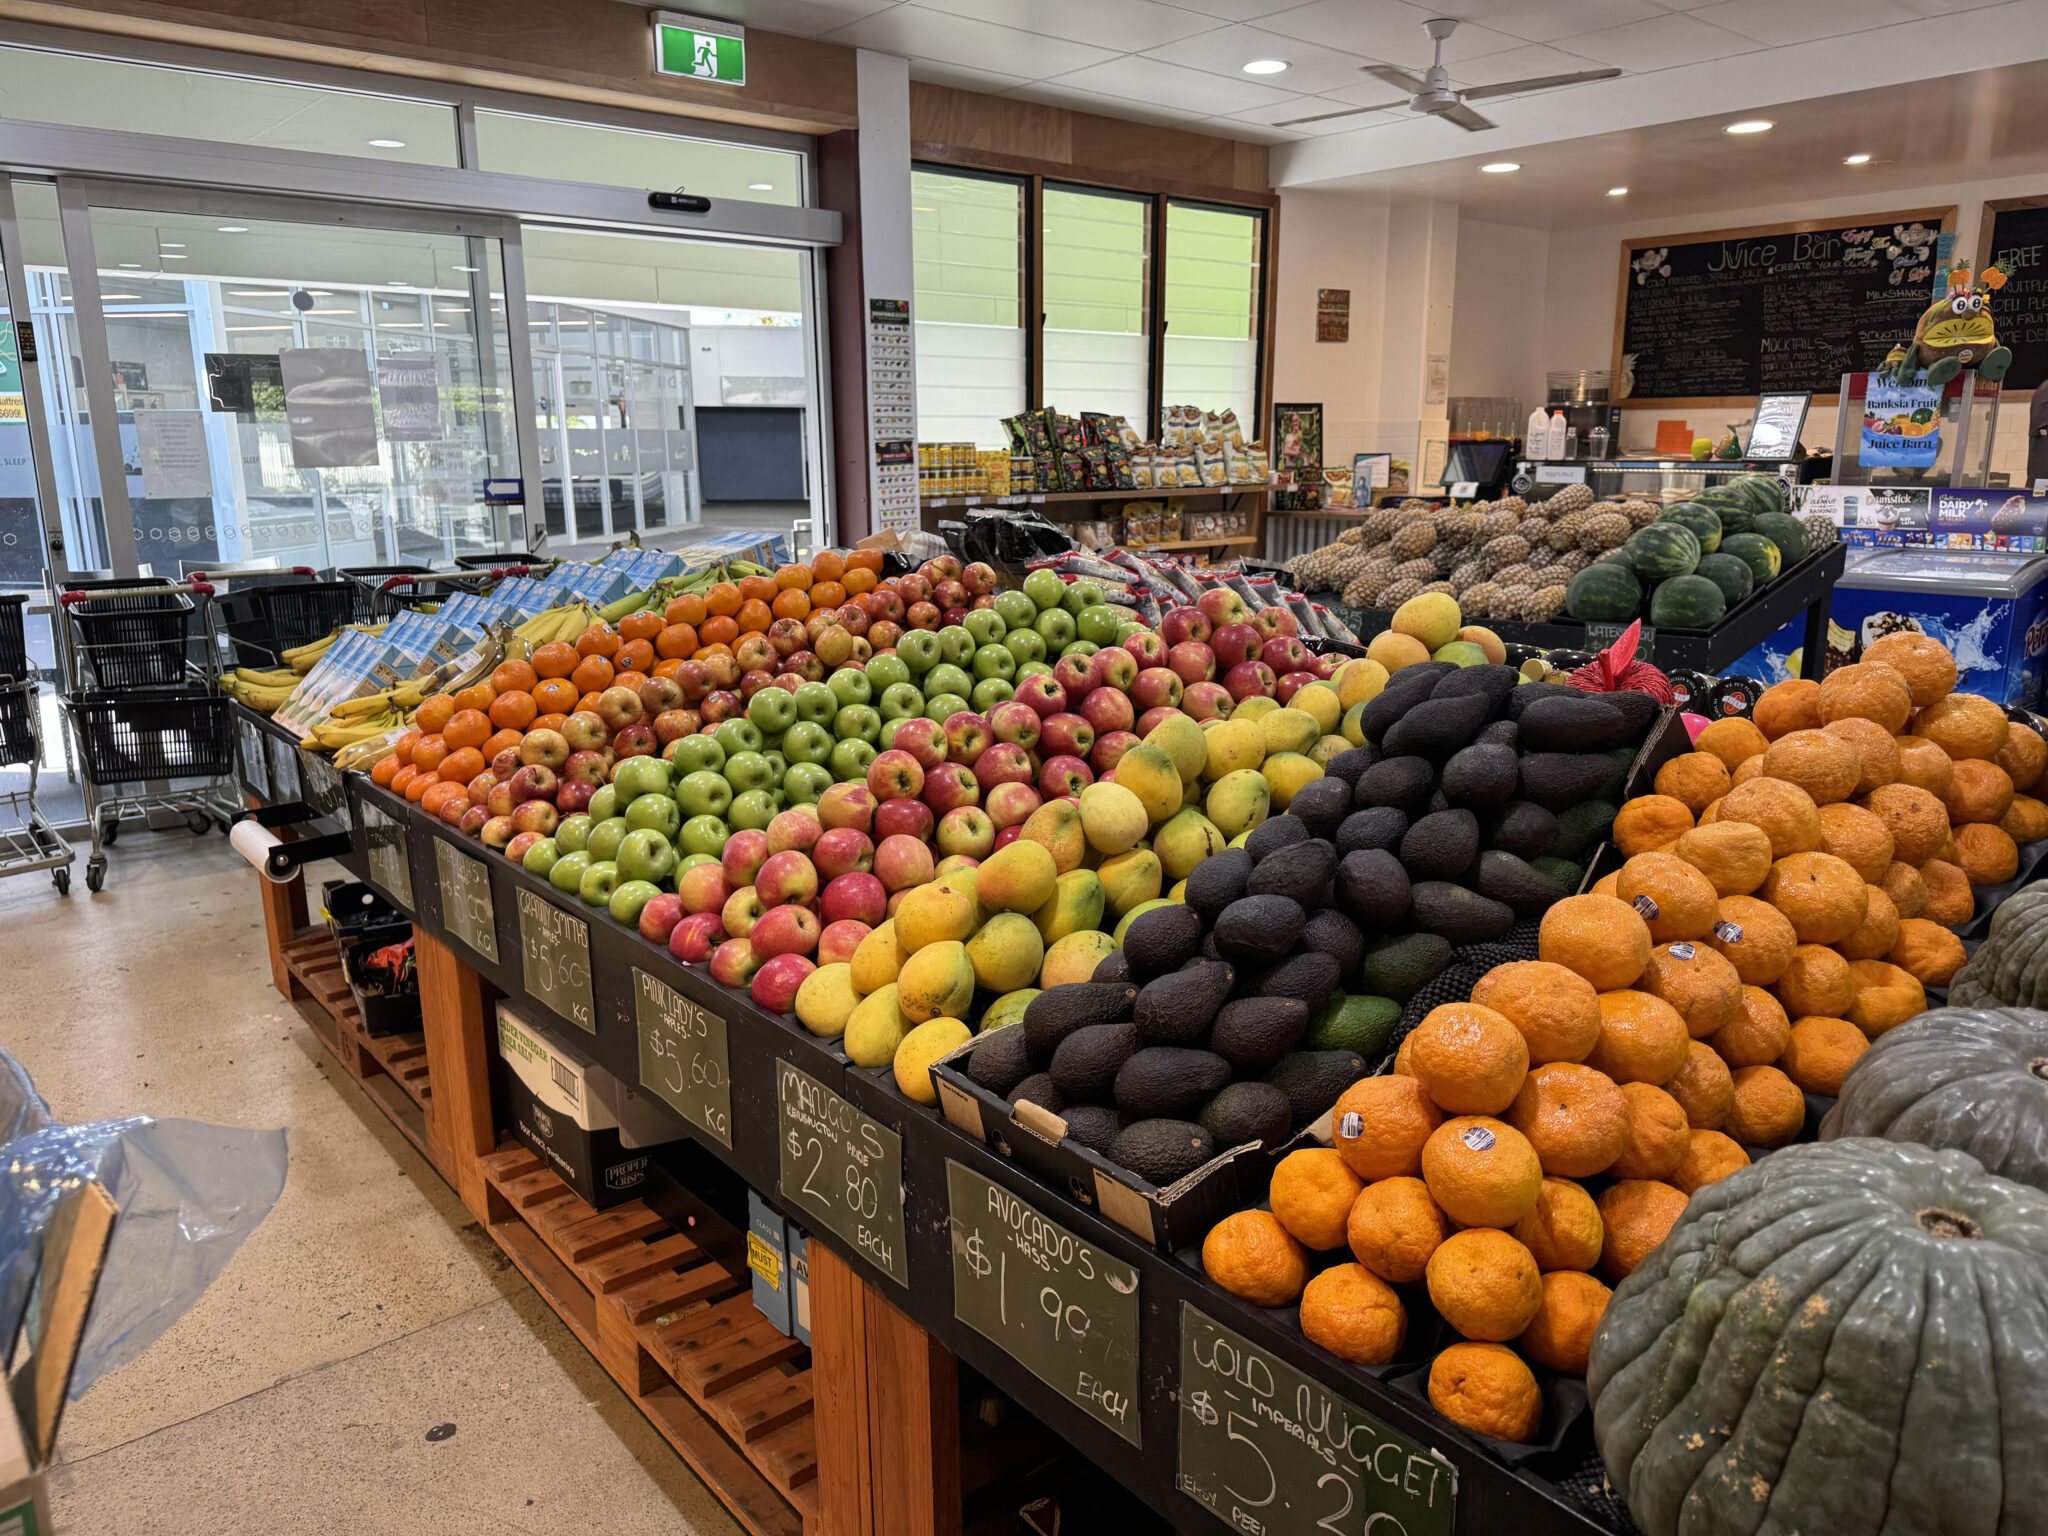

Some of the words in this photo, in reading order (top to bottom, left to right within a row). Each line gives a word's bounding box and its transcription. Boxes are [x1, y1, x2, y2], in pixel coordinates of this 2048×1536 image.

[1708, 241, 1777, 272] Juice
[1793, 233, 1840, 262] Bar
[1998, 245, 2044, 267] FREE
[1739, 269, 1763, 279] JUICE
[1775, 261, 1812, 273] CREATE
[1816, 260, 1842, 269] YOUR
[1866, 289, 1931, 300] MILKSHAKES
[1994, 315, 2014, 326] MIX
[1761, 337, 1828, 353] MOCKTAILS
[1858, 328, 1916, 340] SMOOTHIE
[1820, 342, 1854, 362] COMING
[1821, 356, 1851, 370] SOON
[1877, 378, 1932, 389] Weom
[1868, 399, 1909, 409] Banksia
[1911, 399, 1938, 409] Fruit
[1868, 439, 1899, 449] Juice
[1902, 439, 1932, 449] Barn
[1939, 501, 1974, 510] DAIRY
[1939, 509, 1968, 518] MILK
[519, 891, 551, 928] GRANNY
[553, 911, 588, 949] SMITHS
[476, 929, 492, 953] KG
[572, 1002, 589, 1026] KG
[641, 974, 667, 1011] PINK
[667, 989, 707, 1038] LADY'S
[505, 1034, 517, 1051] SEA
[517, 1043, 533, 1065] SALT
[518, 1031, 549, 1065] VINEGAR
[649, 1028, 721, 1094] $5.60
[704, 1104, 726, 1136] KG
[782, 1071, 885, 1160] MANGO'S
[785, 1102, 839, 1144] KENSINGTON
[846, 1141, 869, 1168] PRIDE
[609, 1157, 649, 1180] PROPER
[614, 1169, 645, 1187] CRISPS
[786, 1126, 879, 1220] $2.80
[756, 1218, 772, 1235] CLASS
[987, 1185, 1096, 1281] AVOCADO'S
[751, 1248, 772, 1268] MUST
[857, 1224, 894, 1272] EACH
[1076, 1371, 1129, 1426] EACH
[1297, 1384, 1439, 1508] NUGGET
